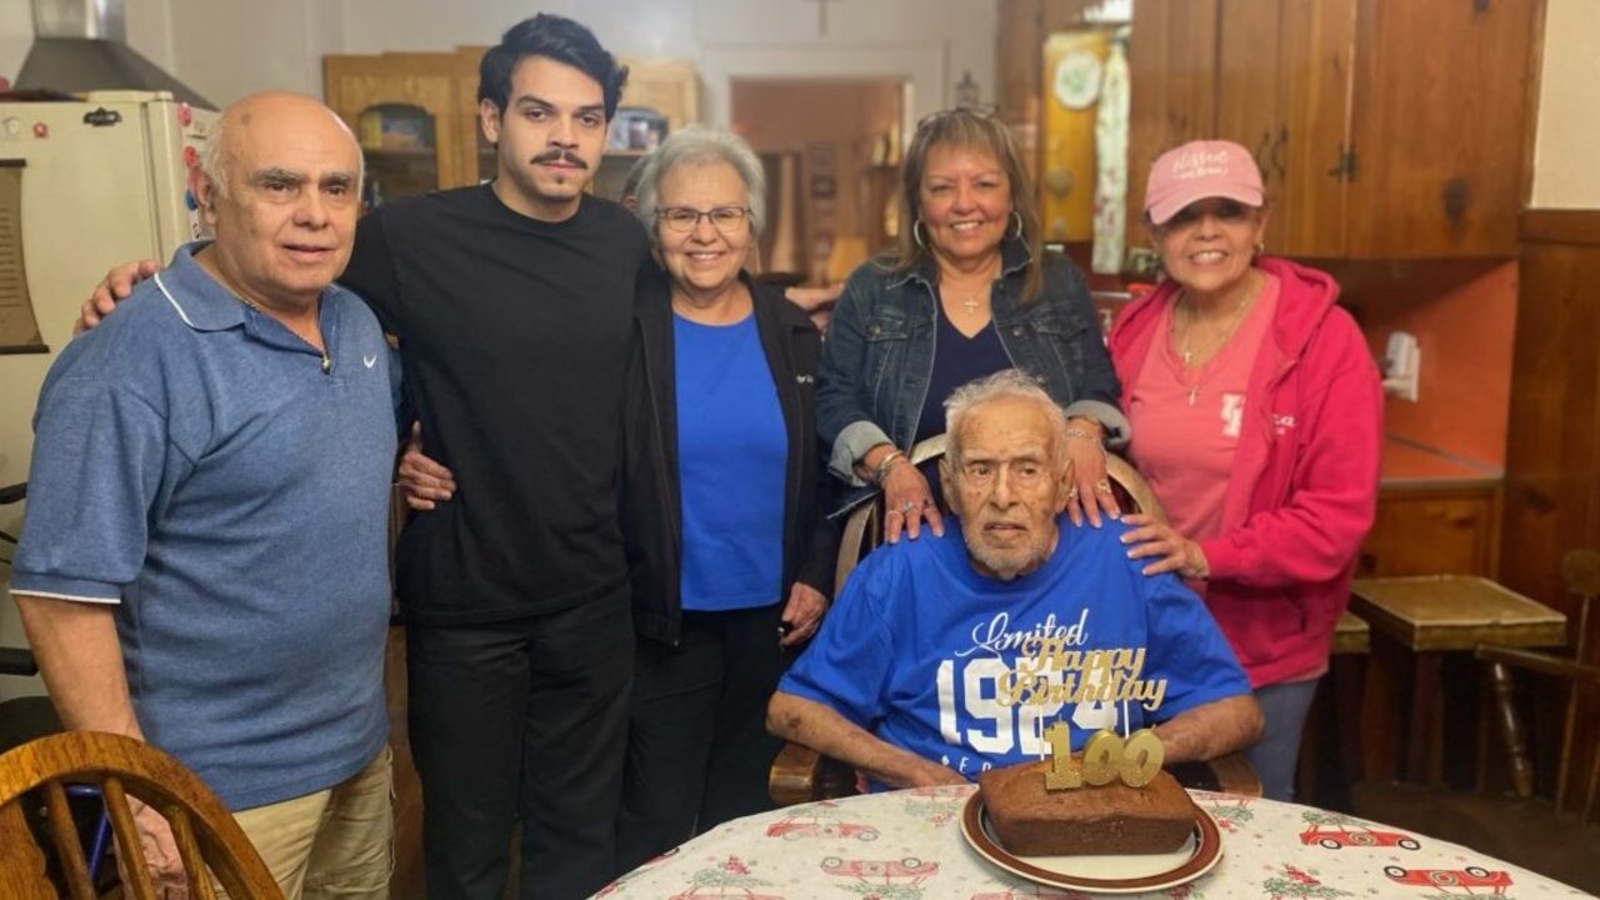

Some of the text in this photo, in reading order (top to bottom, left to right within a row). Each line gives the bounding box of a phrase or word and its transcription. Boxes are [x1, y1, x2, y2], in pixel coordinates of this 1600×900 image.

[998, 664, 1168, 711] Birthday
[1022, 636, 1147, 694] Happy
[1043, 720, 1165, 791] 100
